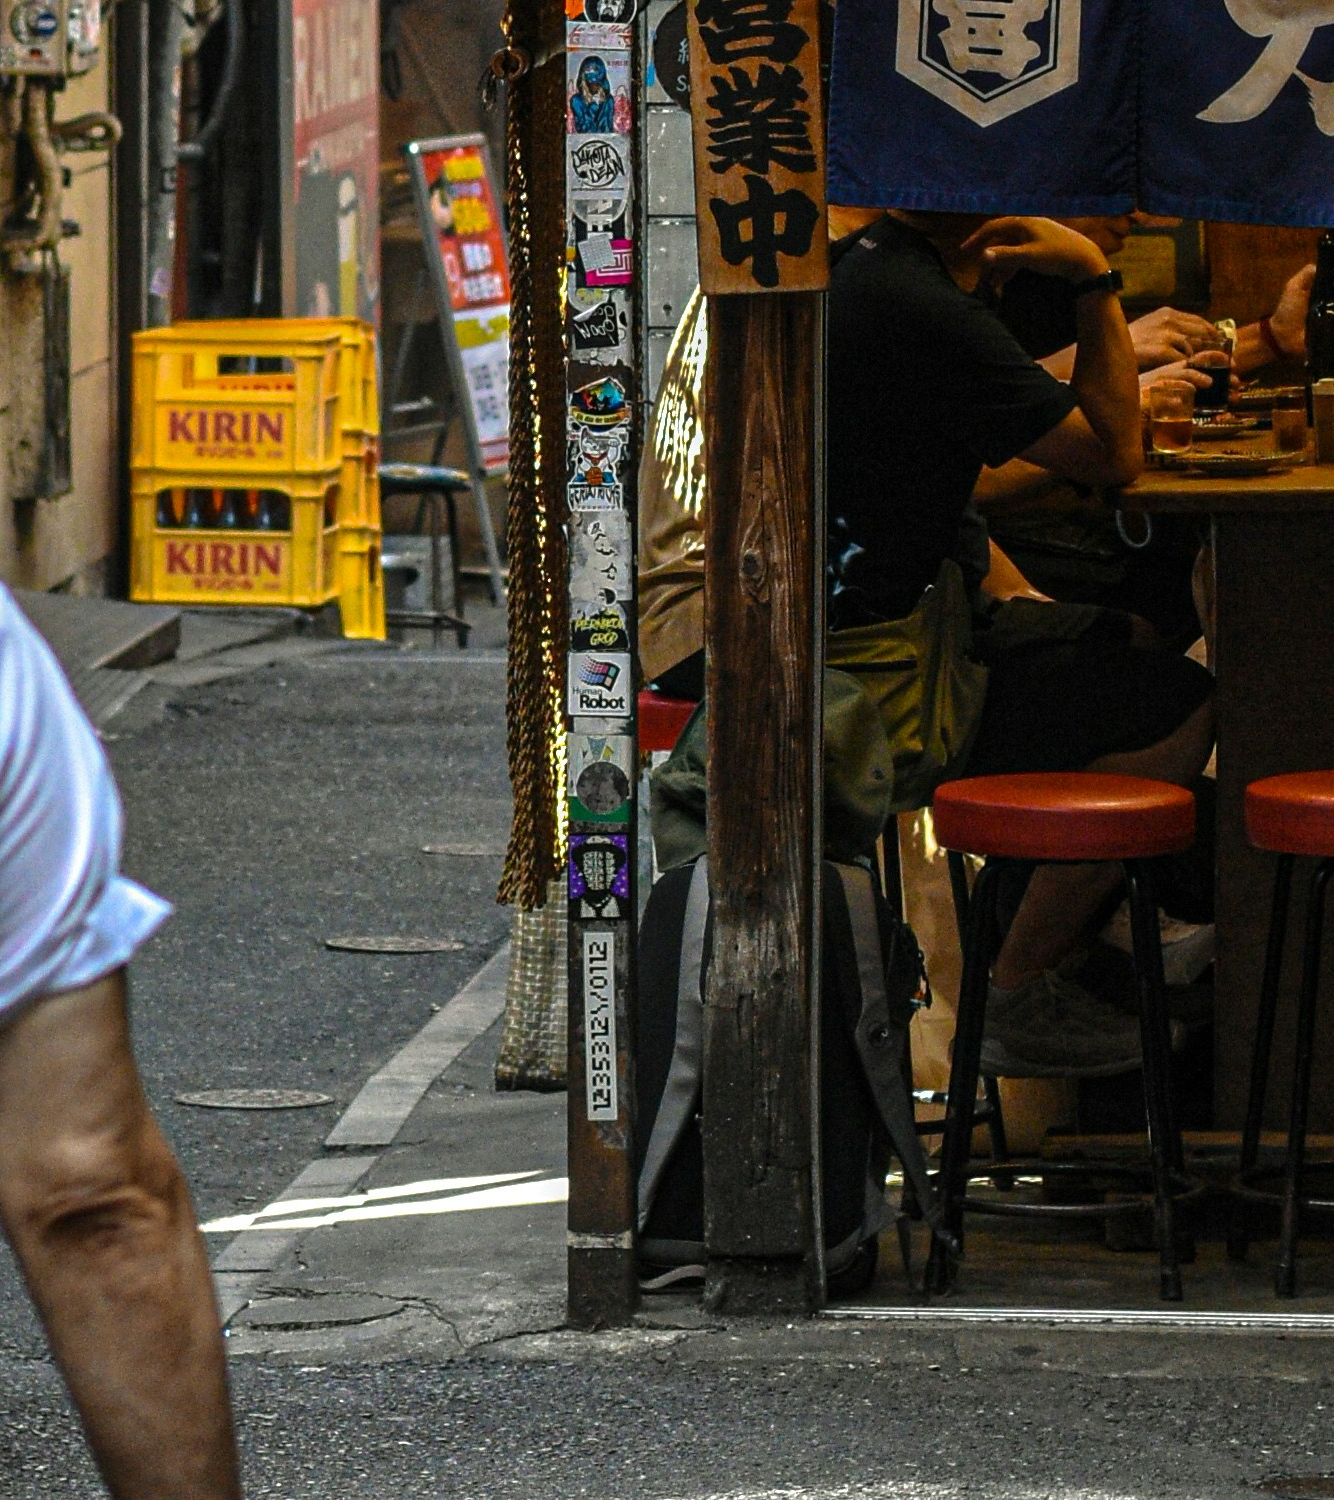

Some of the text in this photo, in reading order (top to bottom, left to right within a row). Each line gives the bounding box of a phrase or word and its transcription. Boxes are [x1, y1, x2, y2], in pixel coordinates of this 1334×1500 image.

[589, 156, 625, 183] DEAN
[169, 410, 284, 443] KIRIN
[167, 541, 281, 575] KIRIN
[579, 693, 626, 710] Robot
